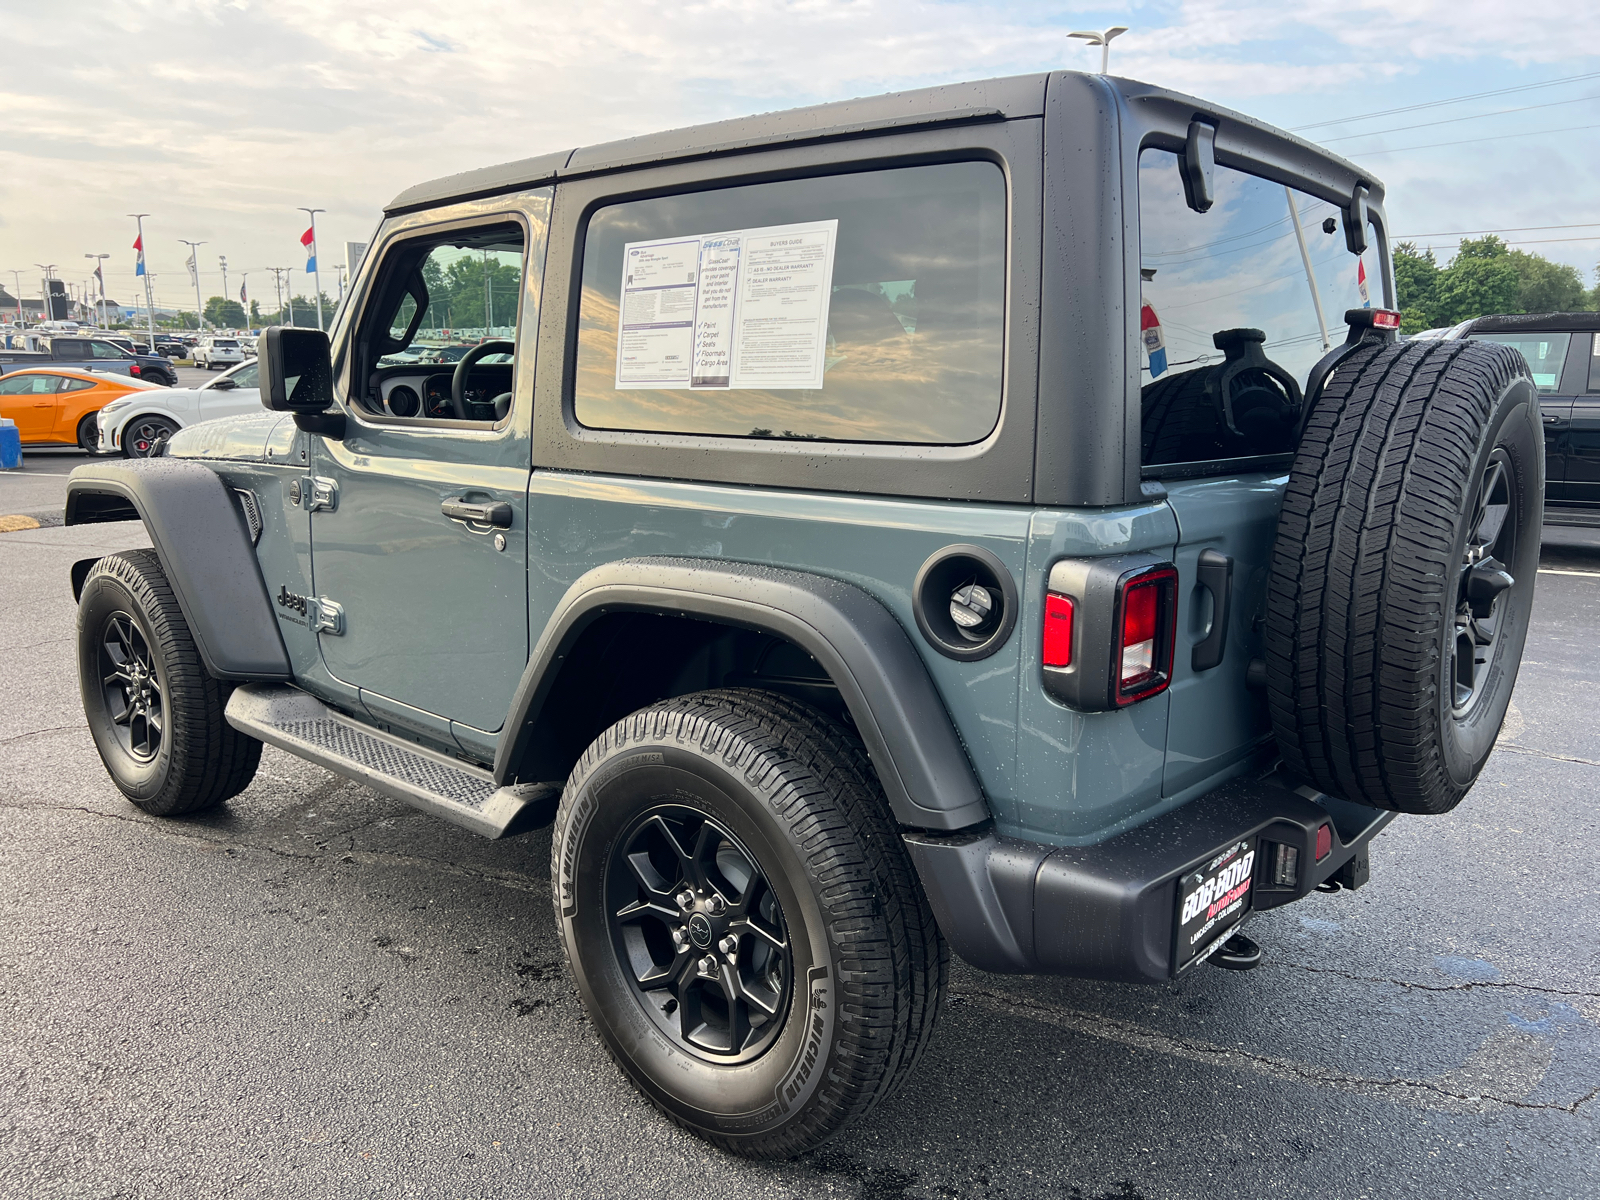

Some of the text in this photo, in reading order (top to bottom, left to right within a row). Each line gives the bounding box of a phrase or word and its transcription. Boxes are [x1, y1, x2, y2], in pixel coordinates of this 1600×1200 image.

[702, 331, 719, 339] Carpet
[700, 359, 715, 367] Cargo
[277, 585, 307, 617] Jeep
[563, 796, 590, 879] MICHELIN
[1190, 918, 1215, 945] LANCASTER
[1217, 898, 1243, 921] COLUMBUS
[785, 1013, 824, 1102] MICHELIN
